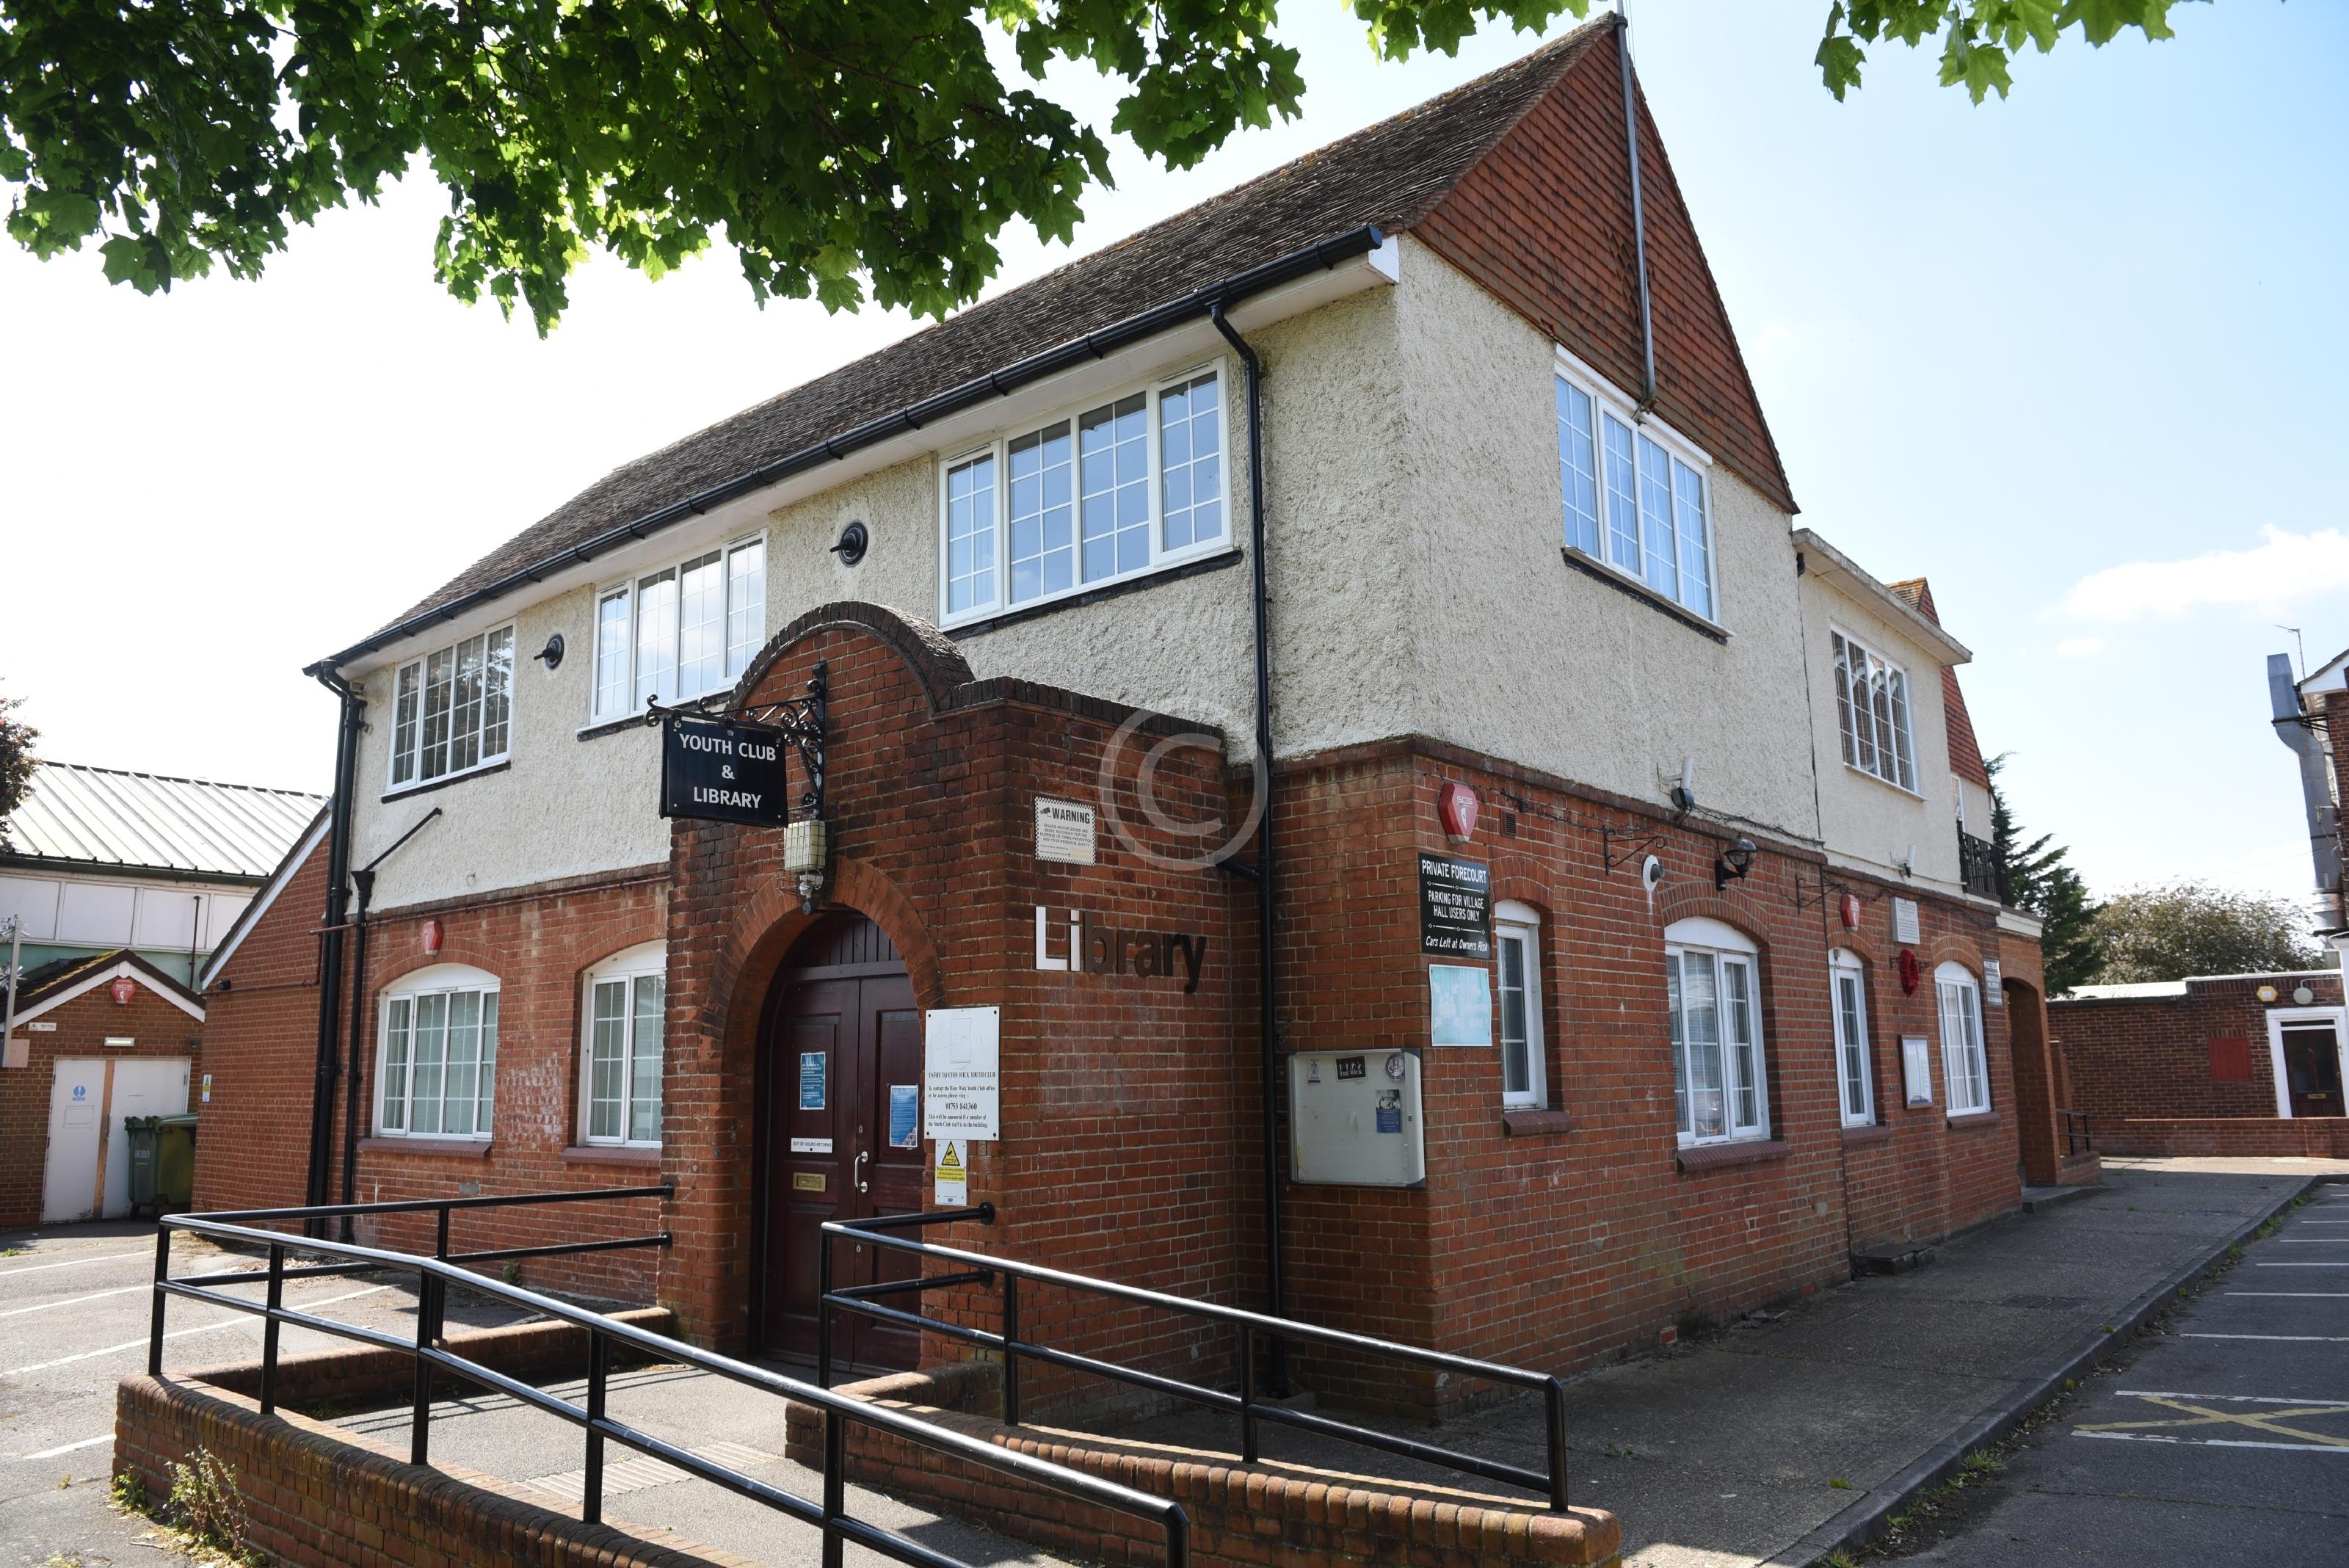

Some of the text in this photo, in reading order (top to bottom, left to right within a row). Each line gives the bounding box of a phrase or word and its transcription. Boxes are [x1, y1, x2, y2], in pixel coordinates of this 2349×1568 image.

[679, 733, 776, 761] YOUTH CLUB
[722, 764, 735, 780] &
[693, 786, 762, 809] LIBRARY
[1052, 807, 1090, 824] WARNING
[1422, 860, 1486, 884] PRIVATE FORECOURT
[1428, 890, 1484, 909] PARKING FOR VILLAGE
[1434, 905, 1480, 921] HALL USERS ONLY
[1036, 907, 1208, 994] Library
[1426, 936, 1488, 952] Cars Left at Owners Risk
